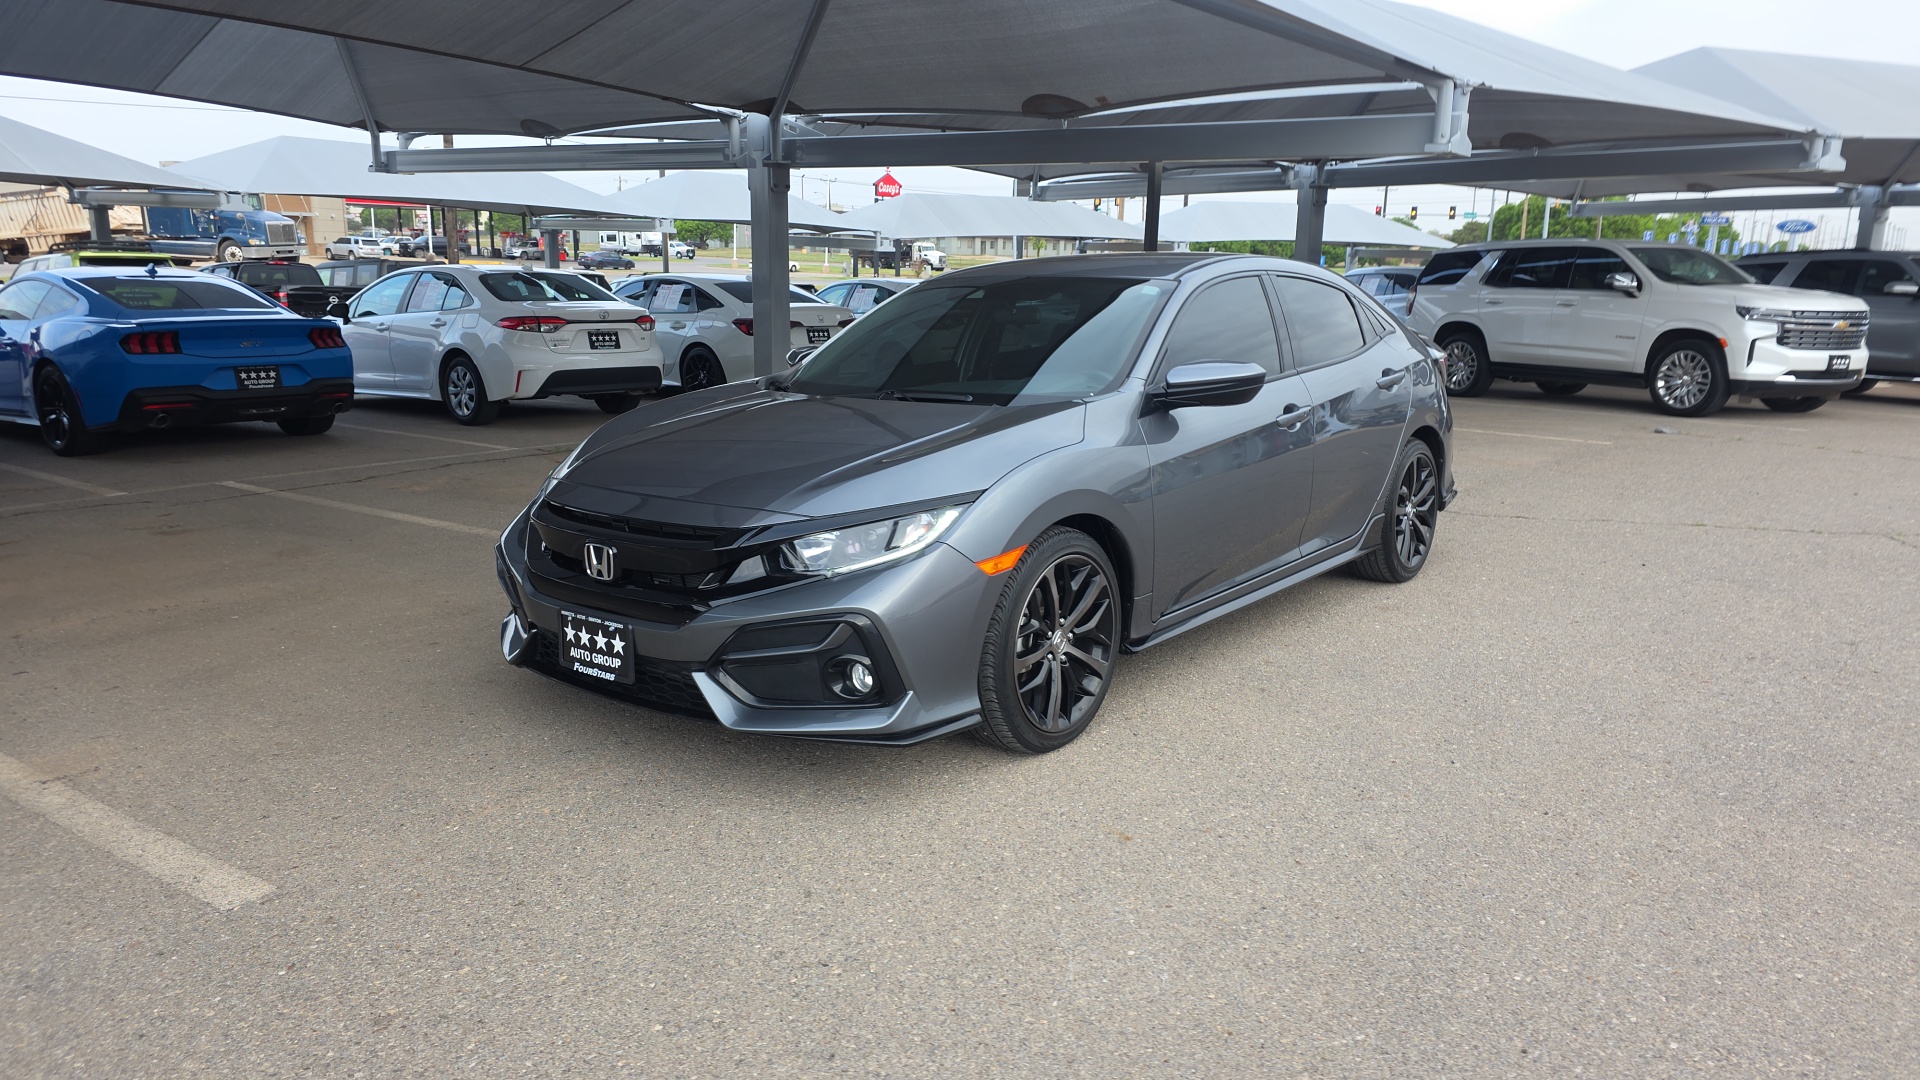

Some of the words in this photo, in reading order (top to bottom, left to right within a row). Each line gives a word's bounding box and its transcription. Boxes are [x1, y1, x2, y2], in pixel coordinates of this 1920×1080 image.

[878, 181, 900, 195] Casey's
[1784, 221, 1810, 232] Ford
[570, 646, 591, 661] AUTO
[592, 652, 622, 668] GROUP
